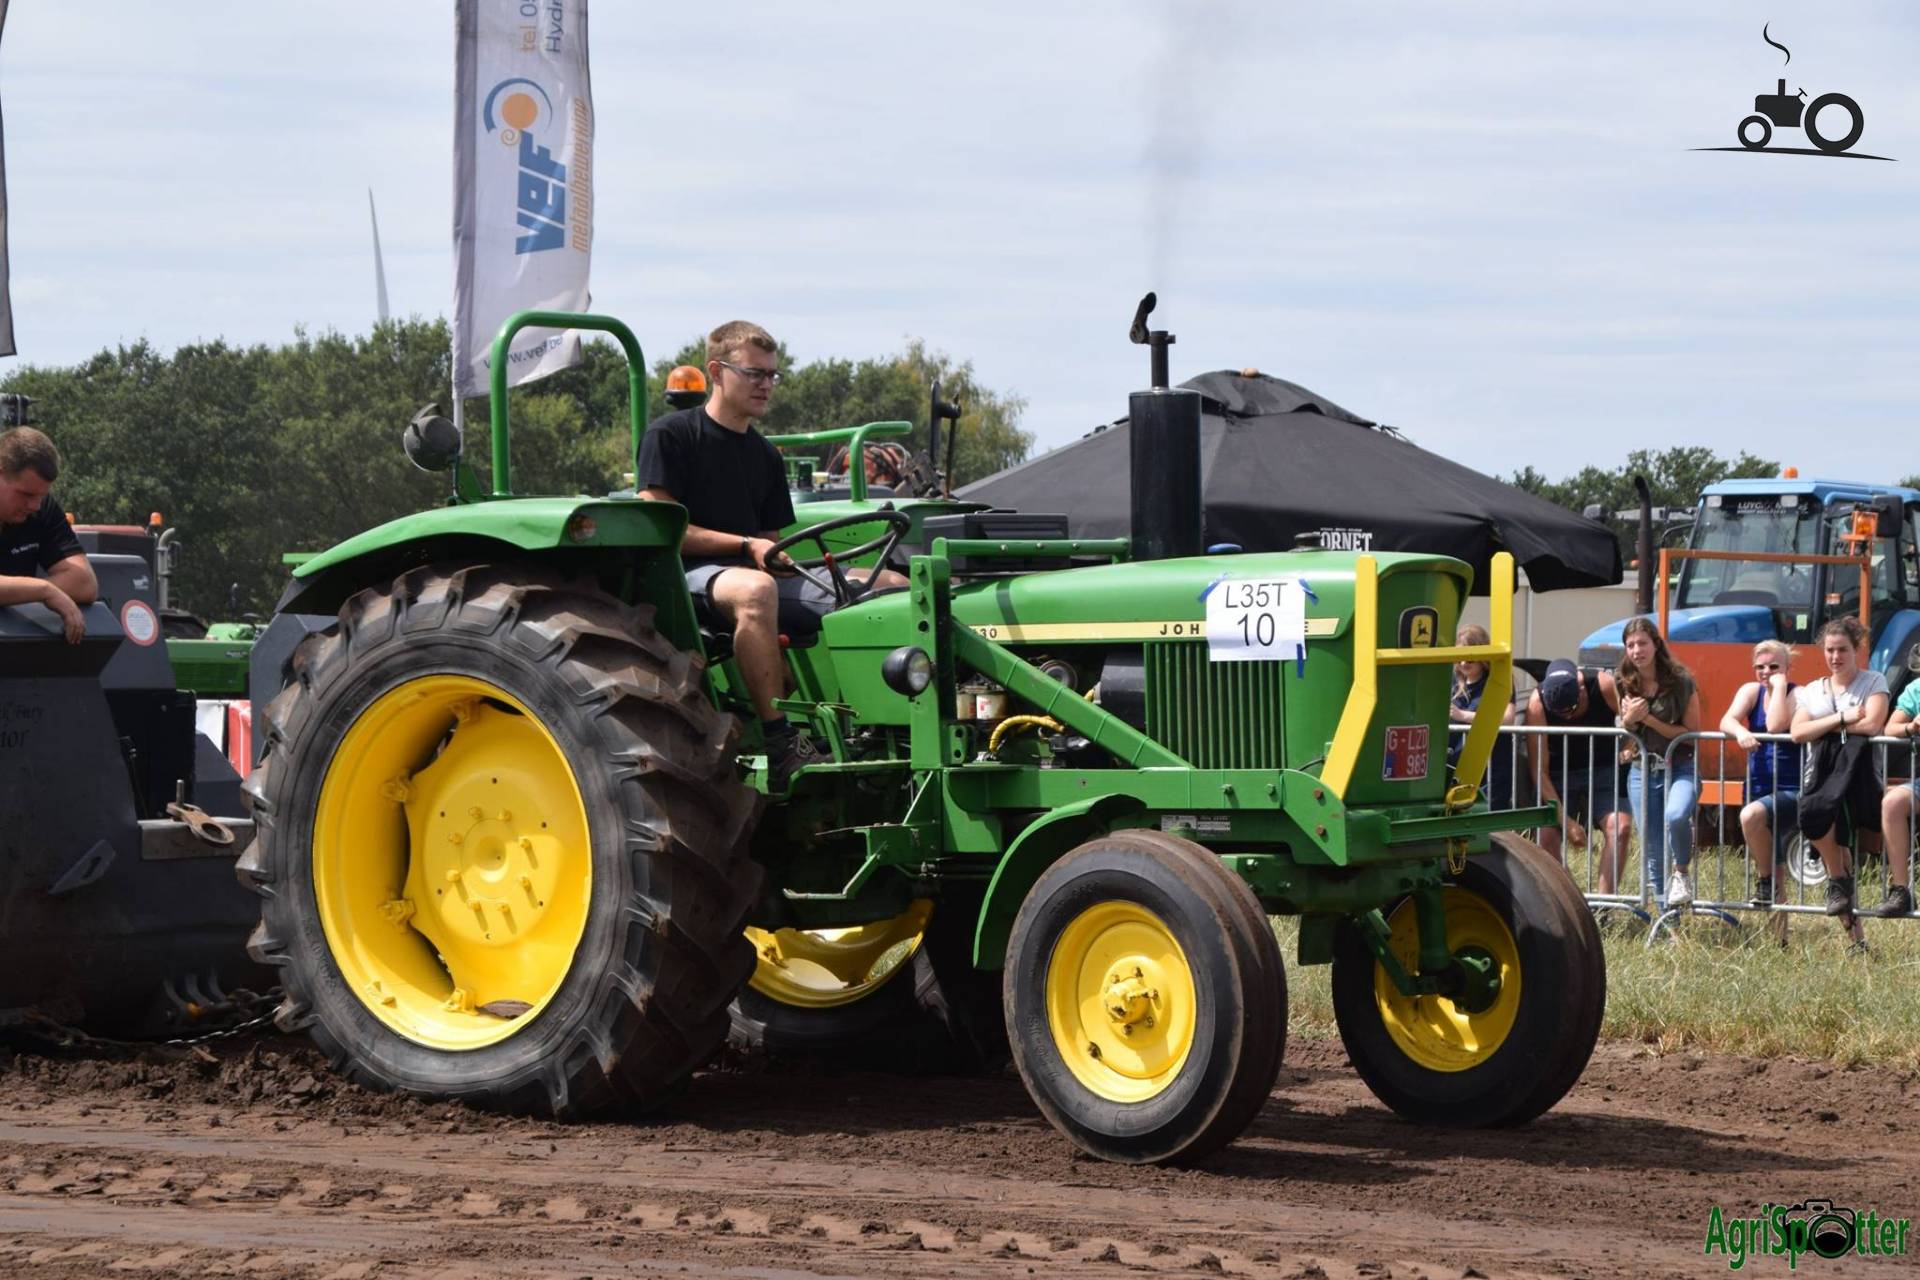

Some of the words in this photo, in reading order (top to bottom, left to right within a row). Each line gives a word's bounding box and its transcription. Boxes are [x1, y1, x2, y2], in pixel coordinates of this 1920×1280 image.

[519, 0, 538, 17] 0
[519, 25, 537, 53] tel
[1313, 531, 1373, 552] ORNET
[1225, 582, 1288, 609] L35T
[978, 627, 998, 640] 30
[1159, 623, 1201, 636] JOH
[1237, 611, 1276, 647] 10
